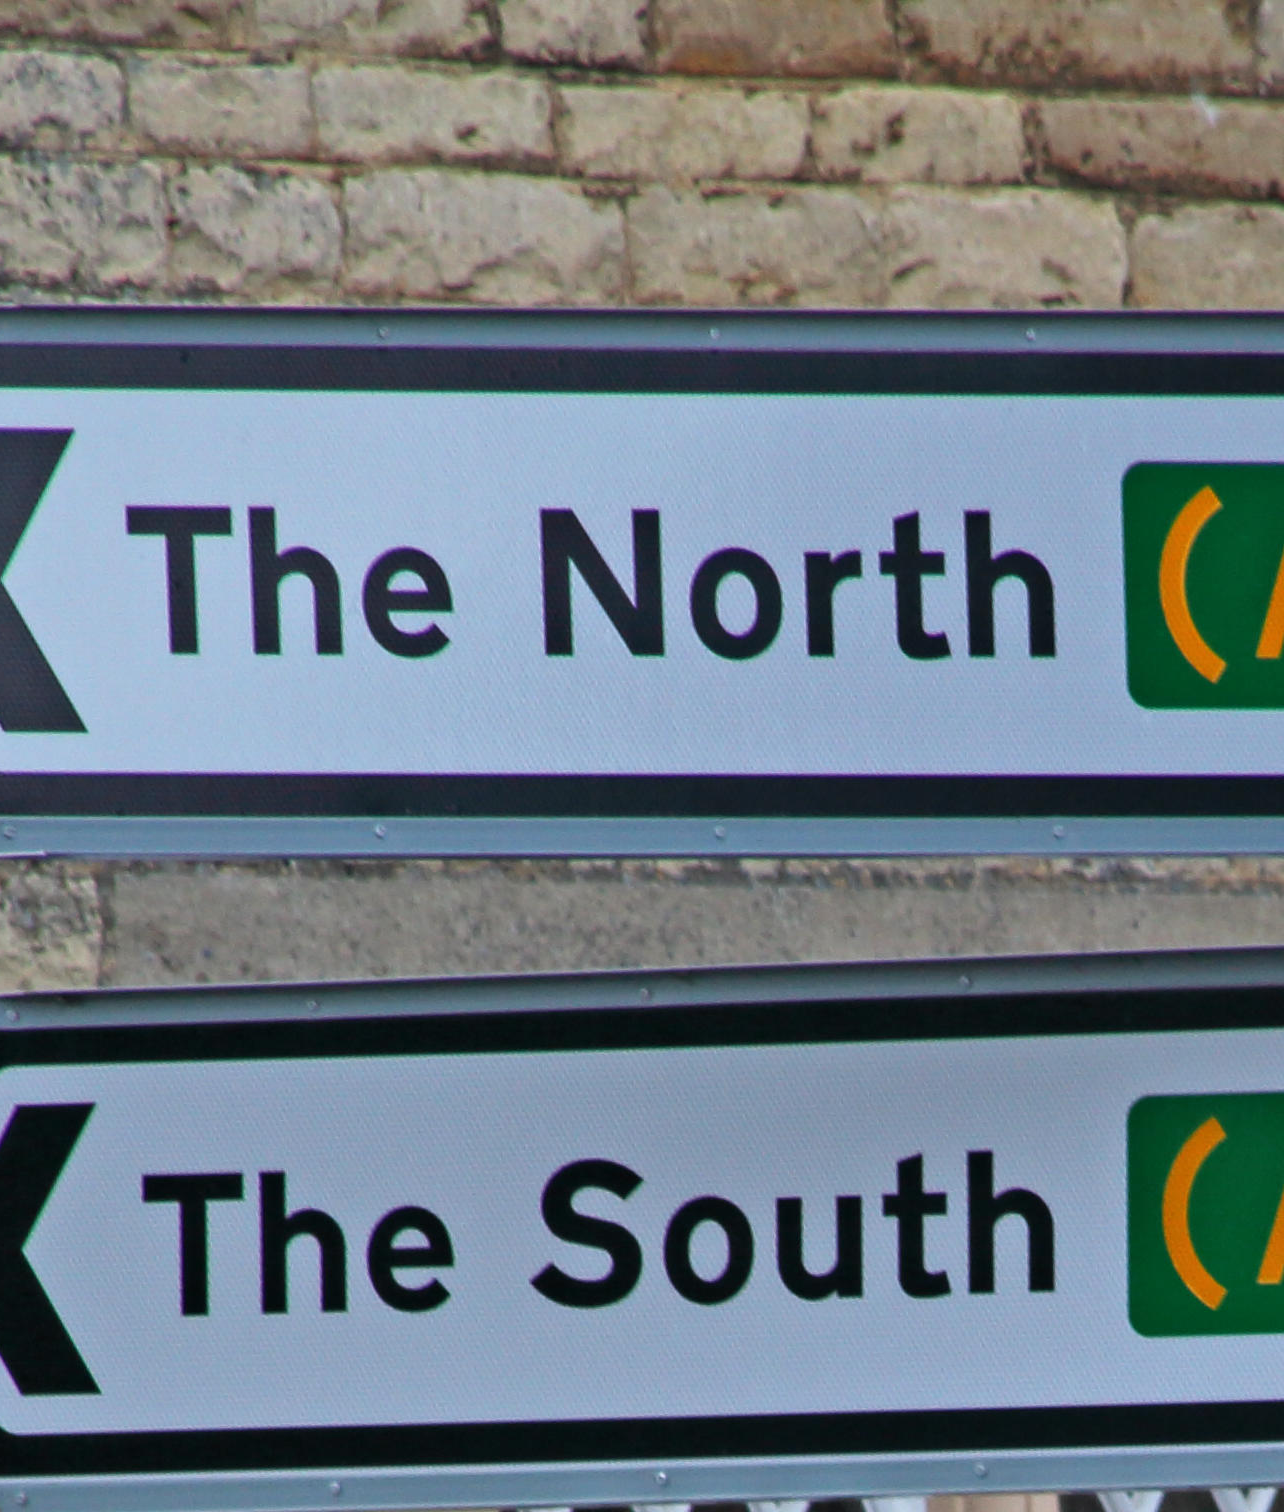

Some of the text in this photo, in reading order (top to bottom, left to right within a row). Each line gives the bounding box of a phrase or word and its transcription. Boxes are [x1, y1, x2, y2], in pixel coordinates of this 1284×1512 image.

[126, 506, 453, 658] The
[540, 508, 1056, 661] North
[141, 1170, 455, 1317] The
[529, 1149, 1055, 1309] South
